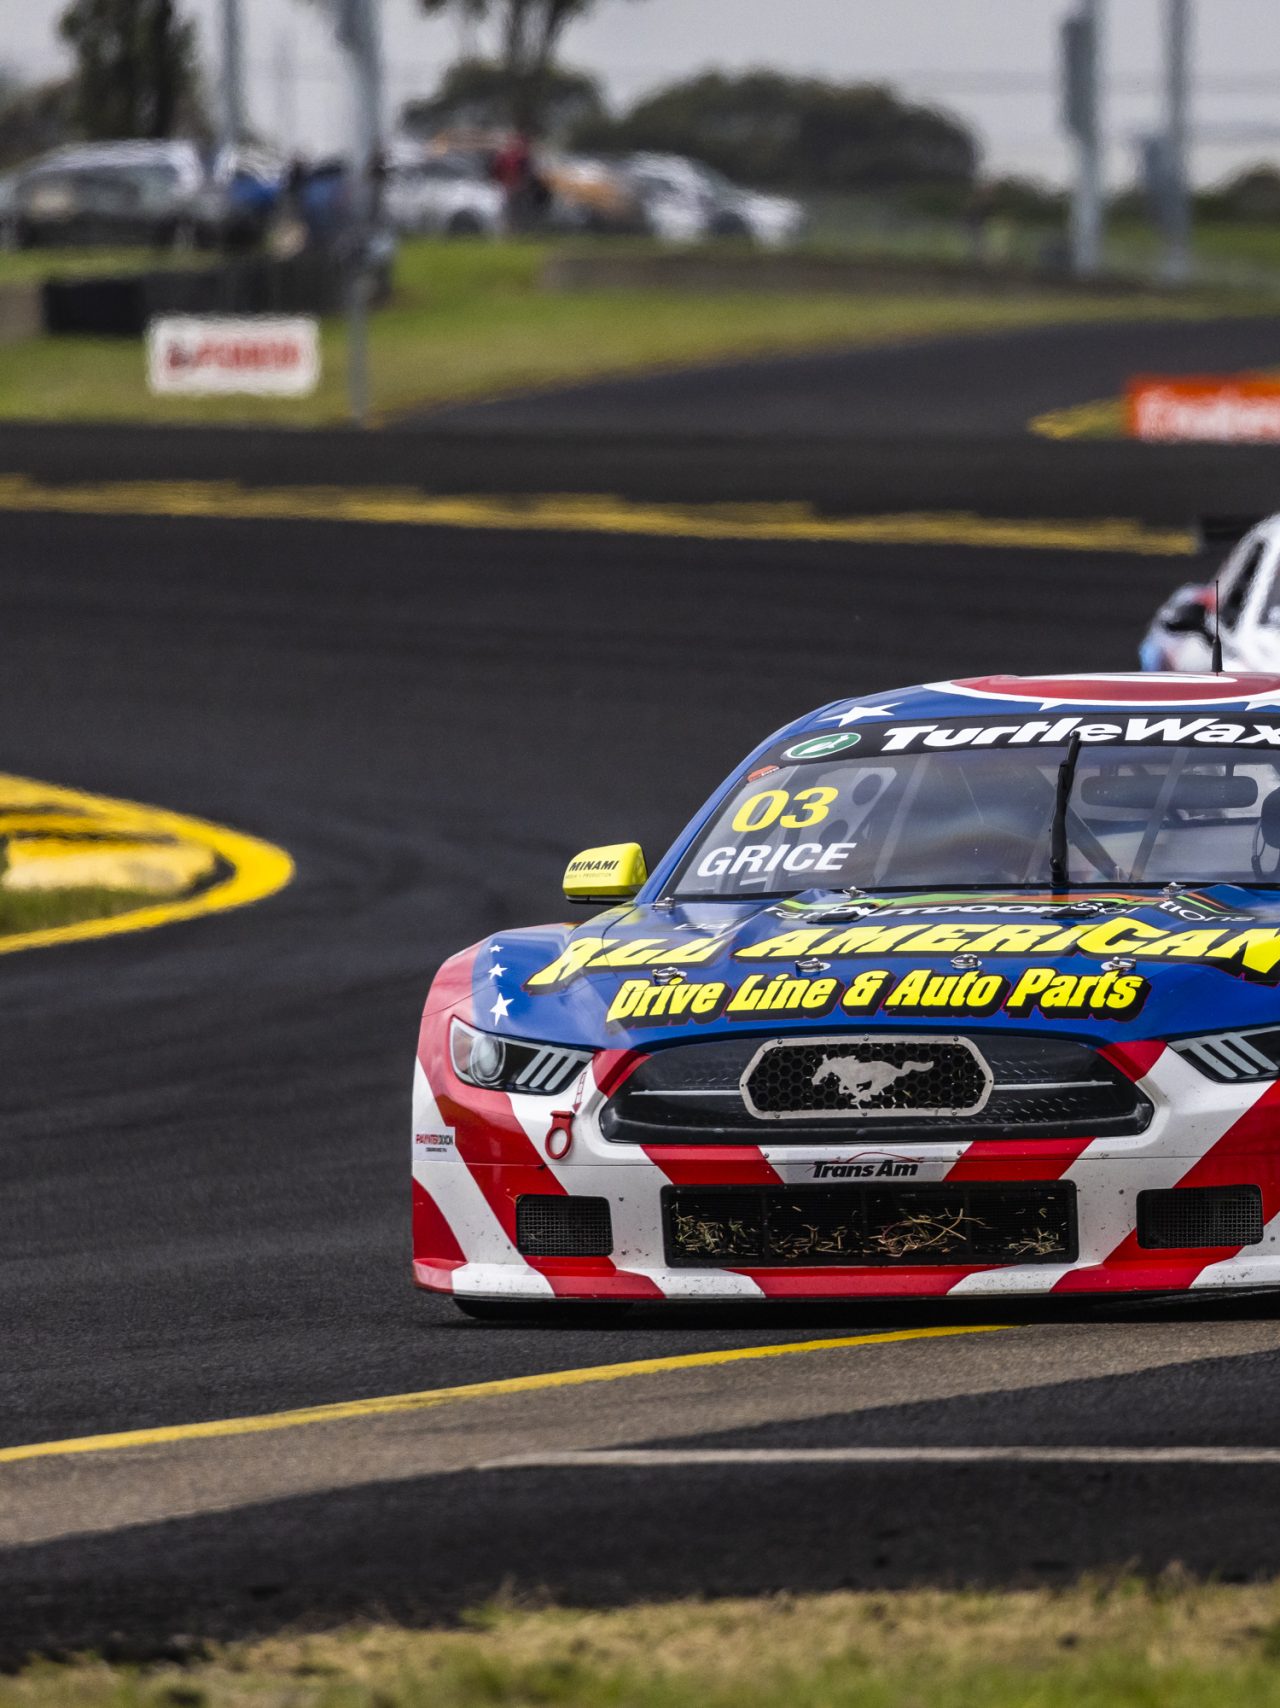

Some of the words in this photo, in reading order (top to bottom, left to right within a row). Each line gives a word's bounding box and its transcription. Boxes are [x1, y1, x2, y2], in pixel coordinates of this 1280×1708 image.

[732, 787, 838, 832] 03
[569, 860, 620, 872] MINAMI
[697, 843, 857, 877] GRICE
[1071, 899, 1256, 922] Soltions
[527, 937, 724, 985] ALL
[606, 976, 727, 1023] Drive
[726, 973, 837, 1012] Line
[842, 970, 889, 1007] &
[886, 969, 1003, 1007] Auto
[1007, 967, 1144, 1008] Parts
[813, 1161, 874, 1178] Trans
[875, 1160, 919, 1177] Am
